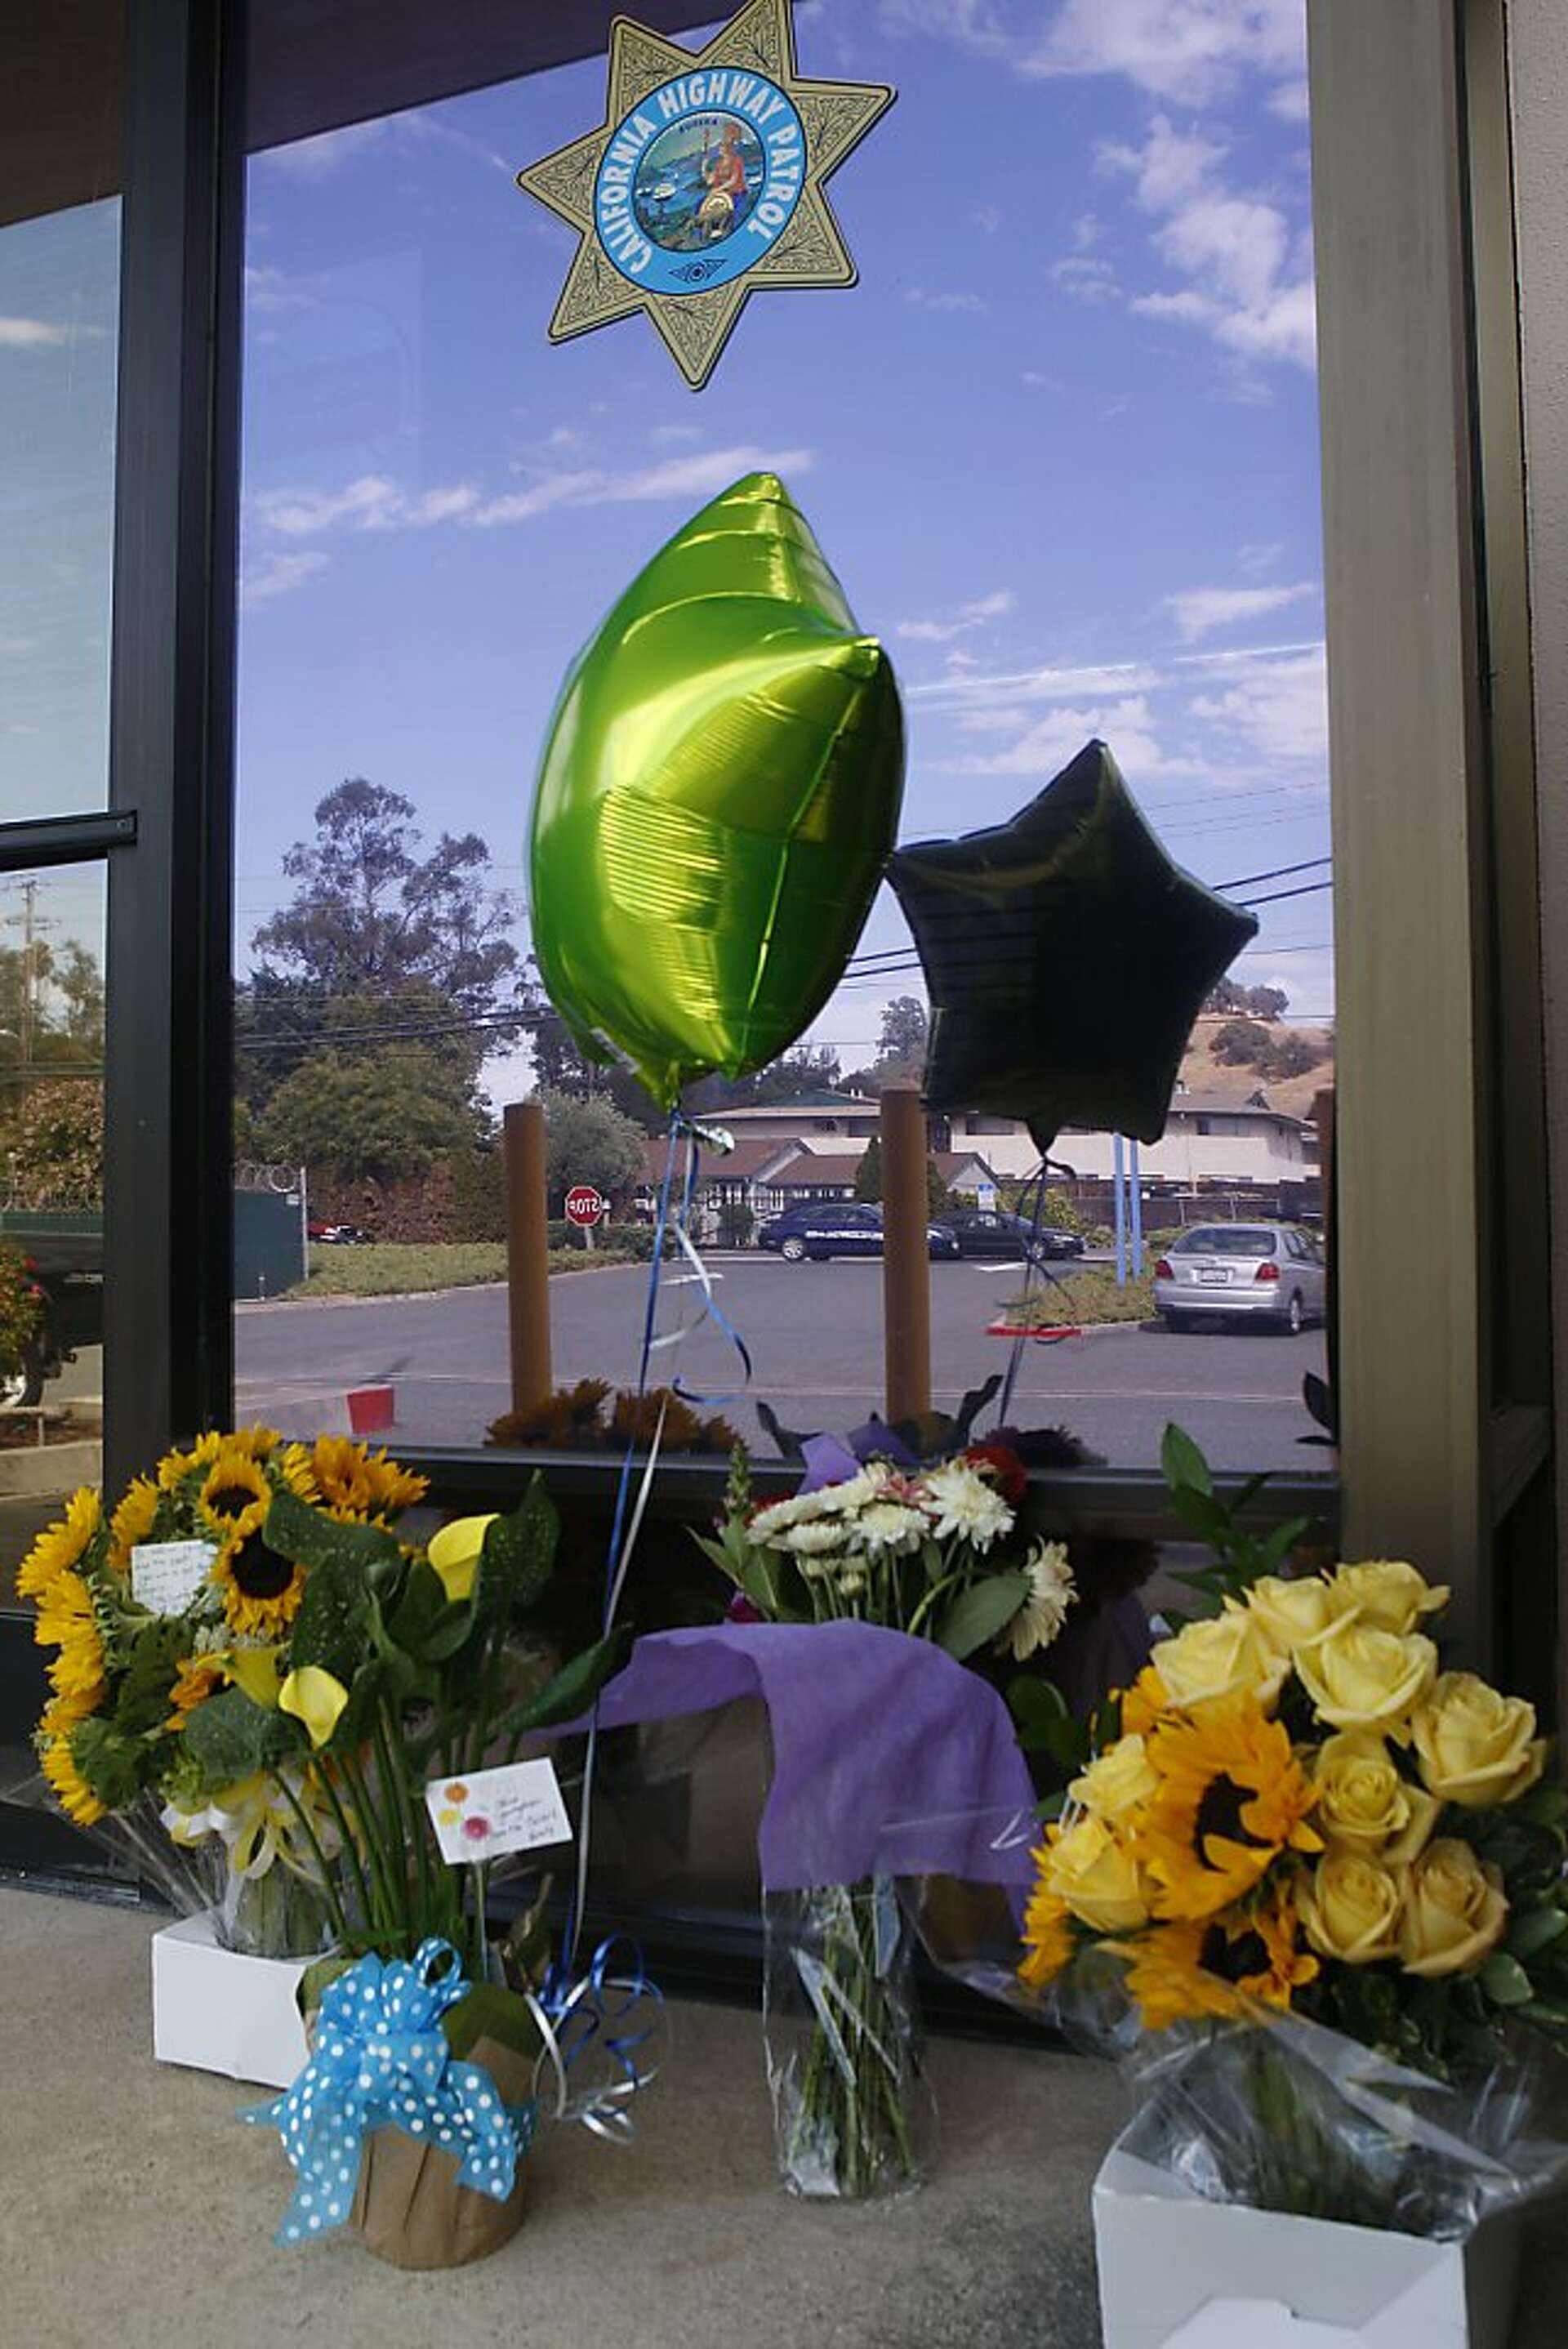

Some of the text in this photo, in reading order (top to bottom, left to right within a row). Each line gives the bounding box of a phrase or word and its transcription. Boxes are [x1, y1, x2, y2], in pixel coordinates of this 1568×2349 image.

[599, 72, 800, 274] CALIFORNIA HIGHWAY PATROL
